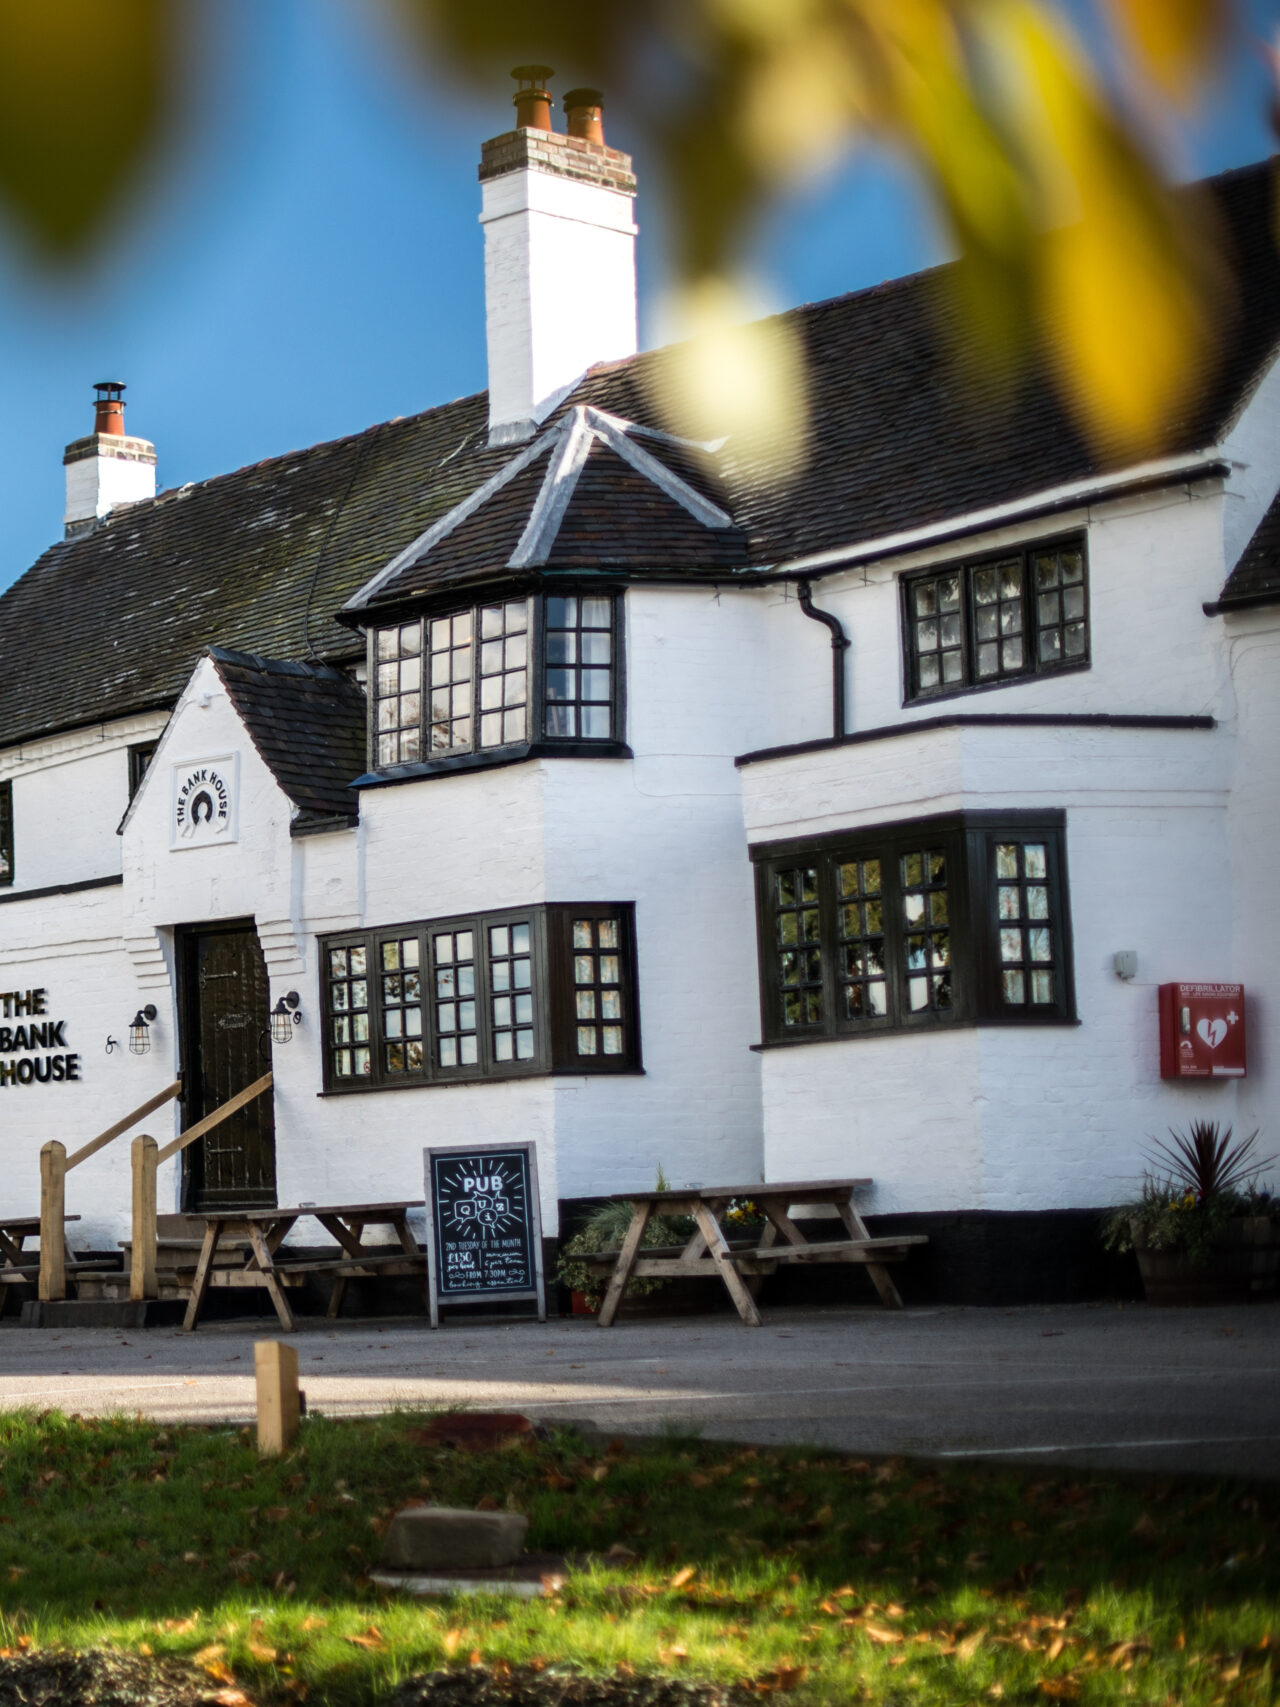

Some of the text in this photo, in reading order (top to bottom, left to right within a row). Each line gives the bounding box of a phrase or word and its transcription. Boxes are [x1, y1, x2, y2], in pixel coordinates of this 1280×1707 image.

[177, 769, 228, 826] THE BANK HOUSE
[1180, 984, 1241, 993] DEFIBRILLATOR
[0, 1054, 79, 1087] HOUSE
[464, 1176, 503, 1192] PUB
[445, 1238, 521, 1252] 2ND TUESDAY OF THE MONTH
[465, 1270, 482, 1279] FROM
